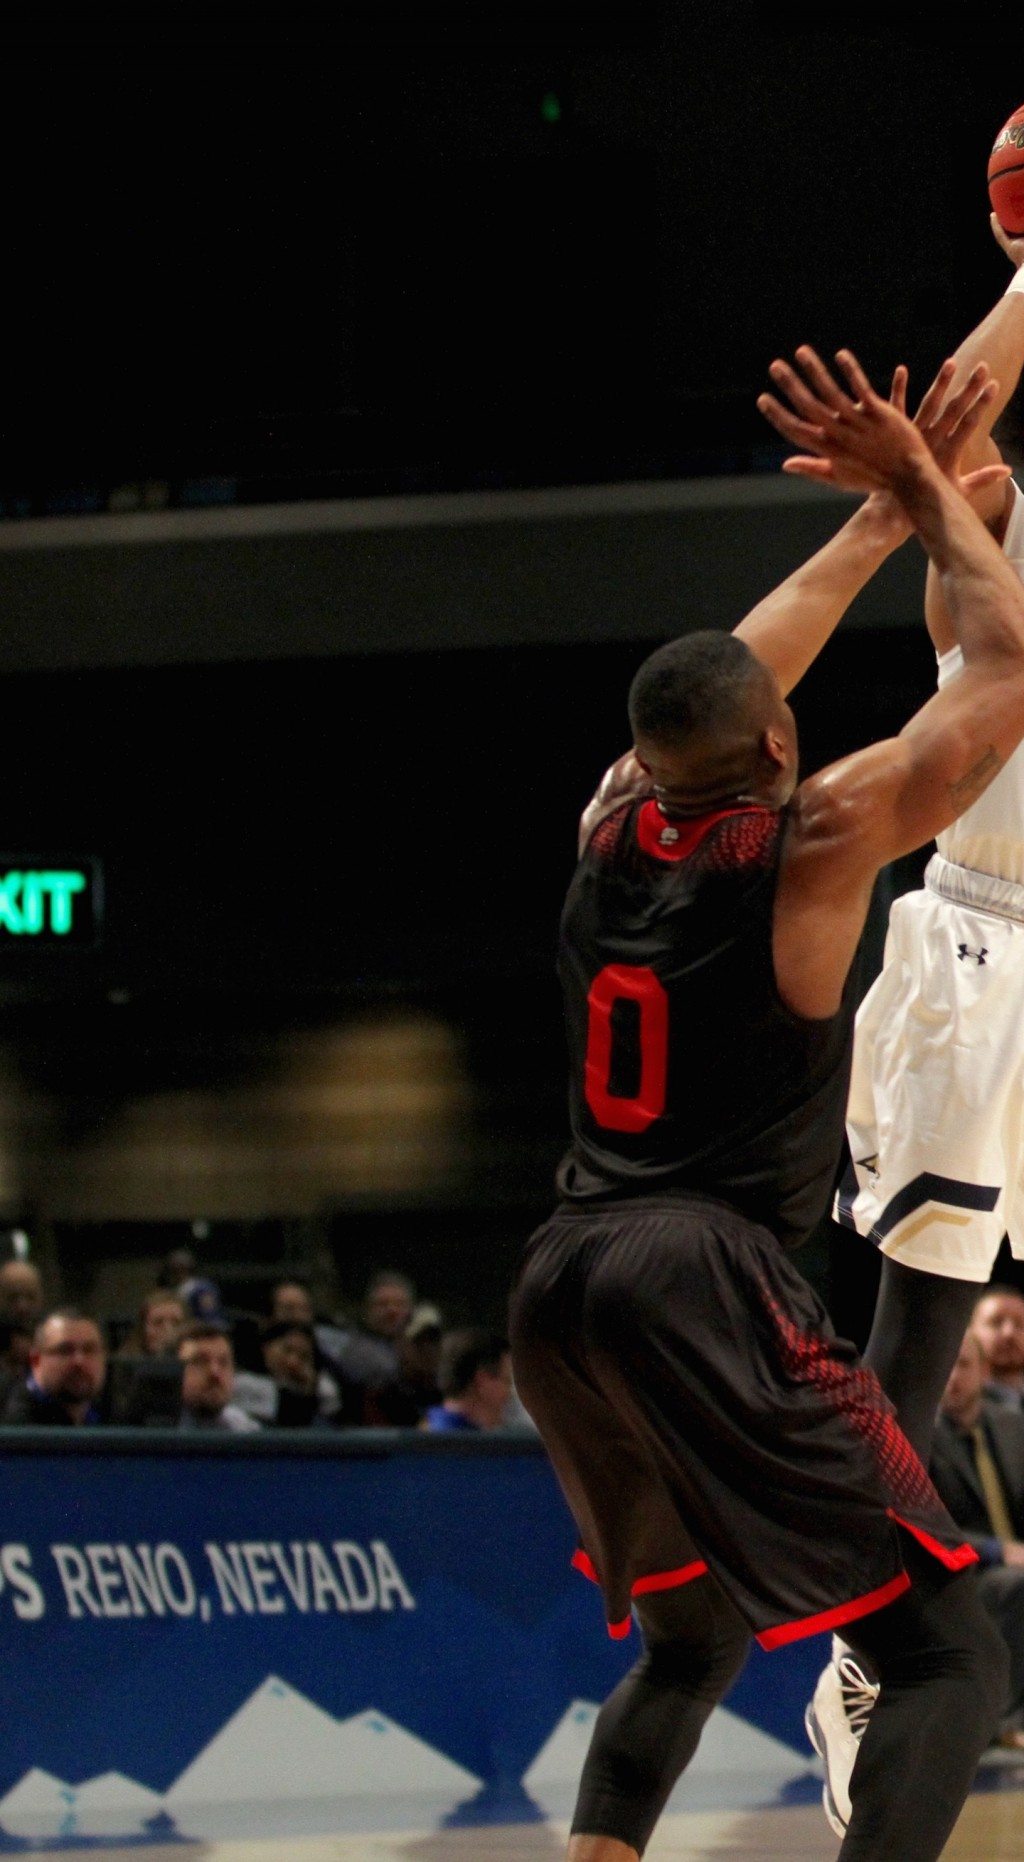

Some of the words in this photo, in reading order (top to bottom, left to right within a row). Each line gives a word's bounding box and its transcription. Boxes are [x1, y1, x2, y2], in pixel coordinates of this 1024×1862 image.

[584, 963, 668, 1134] 0
[0, 1543, 45, 1620] S
[50, 1541, 211, 1622] RENO,
[204, 1540, 416, 1615] NEVADA
